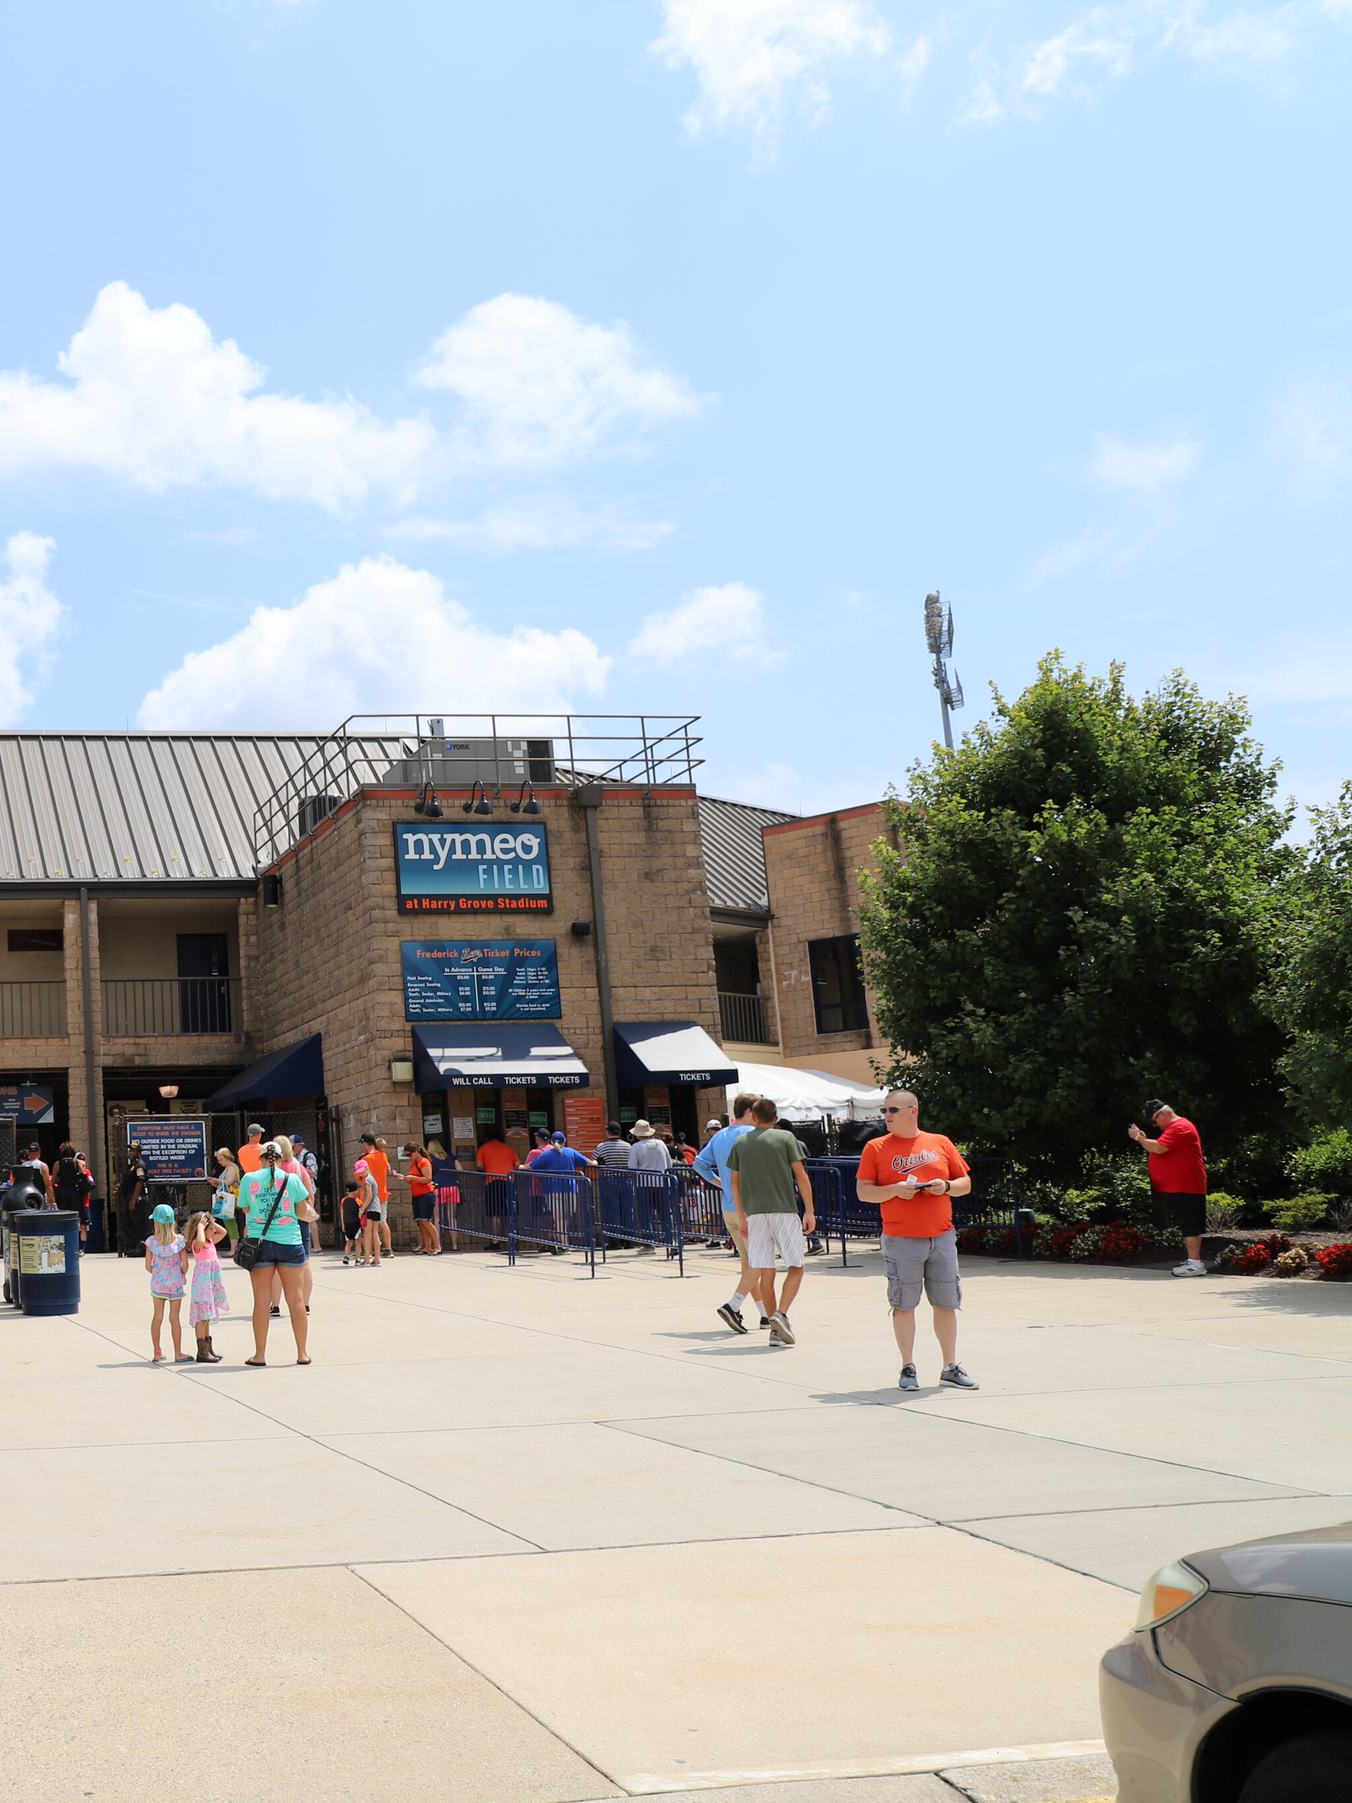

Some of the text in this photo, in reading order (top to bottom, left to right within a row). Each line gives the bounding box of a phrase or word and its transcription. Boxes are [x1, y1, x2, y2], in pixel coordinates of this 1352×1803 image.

[402, 833, 540, 870] nymeo
[478, 864, 545, 889] FIELD
[406, 898, 548, 910] at Harry Grove Stadium
[416, 949, 458, 958] Frederick
[482, 949, 510, 958] Ticket
[514, 948, 542, 957] Prices
[548, 1076, 580, 1084] TICKETS
[892, 1149, 940, 1172] Orioles
